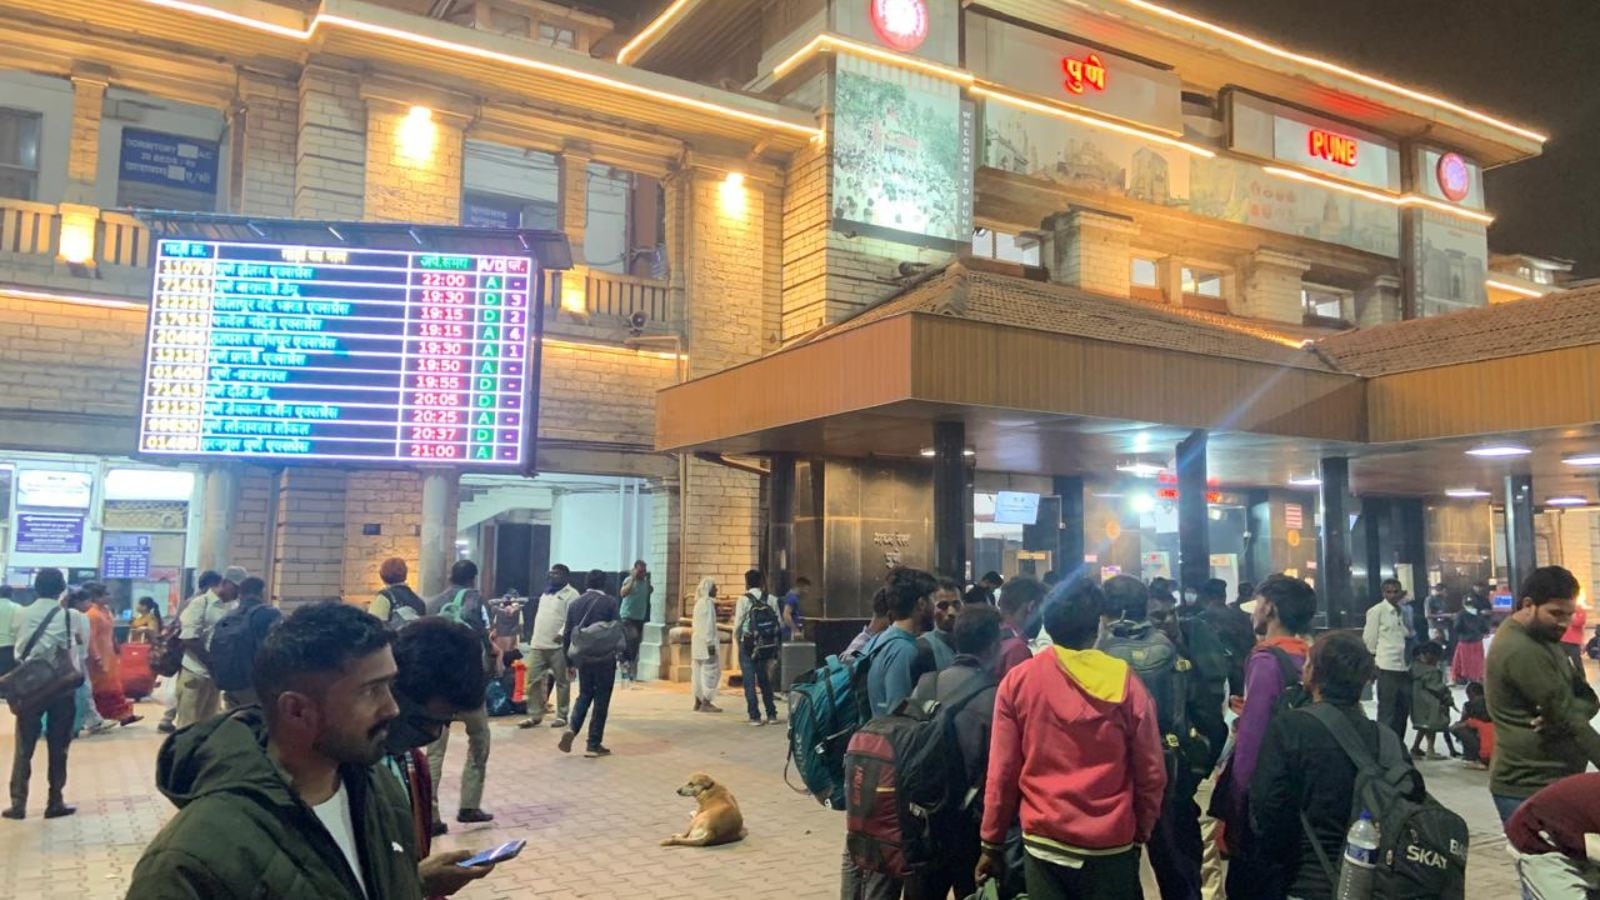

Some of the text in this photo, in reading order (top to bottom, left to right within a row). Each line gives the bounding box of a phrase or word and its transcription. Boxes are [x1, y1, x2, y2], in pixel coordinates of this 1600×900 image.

[1064, 54, 1105, 94] पुणे
[962, 111, 971, 172] WELCOME
[1309, 130, 1358, 167] PUNE
[962, 179, 970, 195] TO
[479, 258, 505, 272] A/D
[421, 274, 498, 288] 22:00 A
[421, 291, 521, 305] 19:30 D 3
[420, 307, 520, 322] 19:15 D 2
[419, 324, 520, 340] 19:15 A 4
[419, 342, 519, 356] 19:30 A 1
[417, 359, 493, 373] 19:50 A
[416, 376, 491, 389] 19:55 D
[414, 393, 490, 406] 20:05 D
[413, 410, 490, 424] 20:25 A
[412, 428, 488, 441] 20:37 D
[411, 445, 488, 458] 21:00 A
[1406, 844, 1449, 869] SKAY
